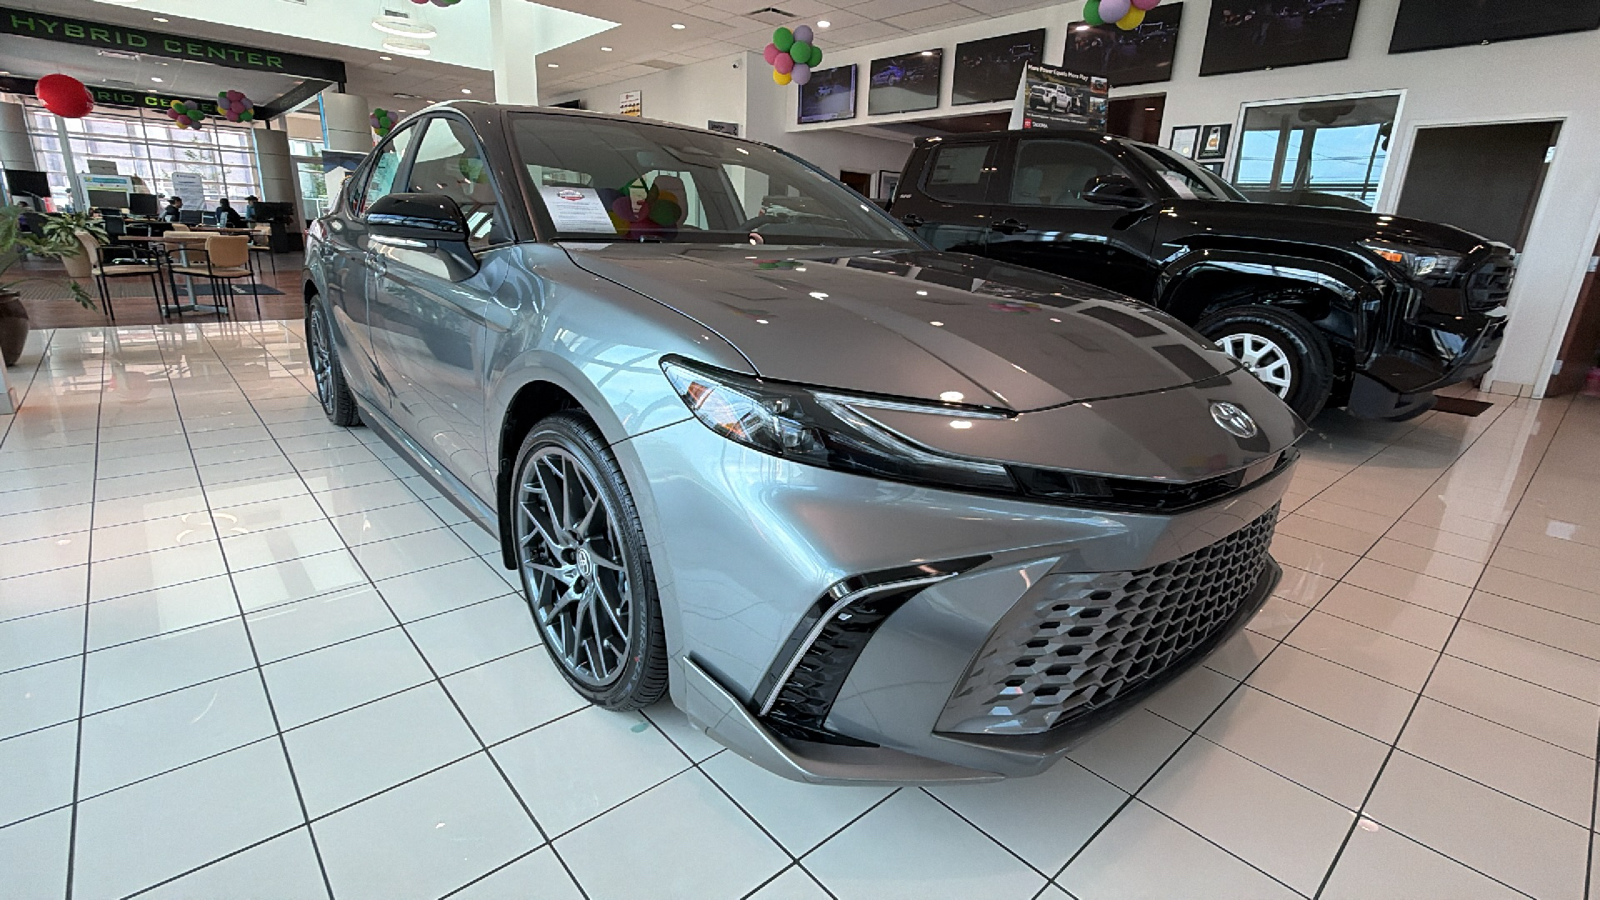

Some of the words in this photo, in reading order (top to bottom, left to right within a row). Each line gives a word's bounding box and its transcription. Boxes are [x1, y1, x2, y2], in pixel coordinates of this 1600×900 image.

[11, 14, 148, 48] HYBRID
[163, 39, 284, 69] CENTER
[1028, 64, 1039, 72] More
[1040, 66, 1053, 74] Power
[1068, 71, 1079, 79] More
